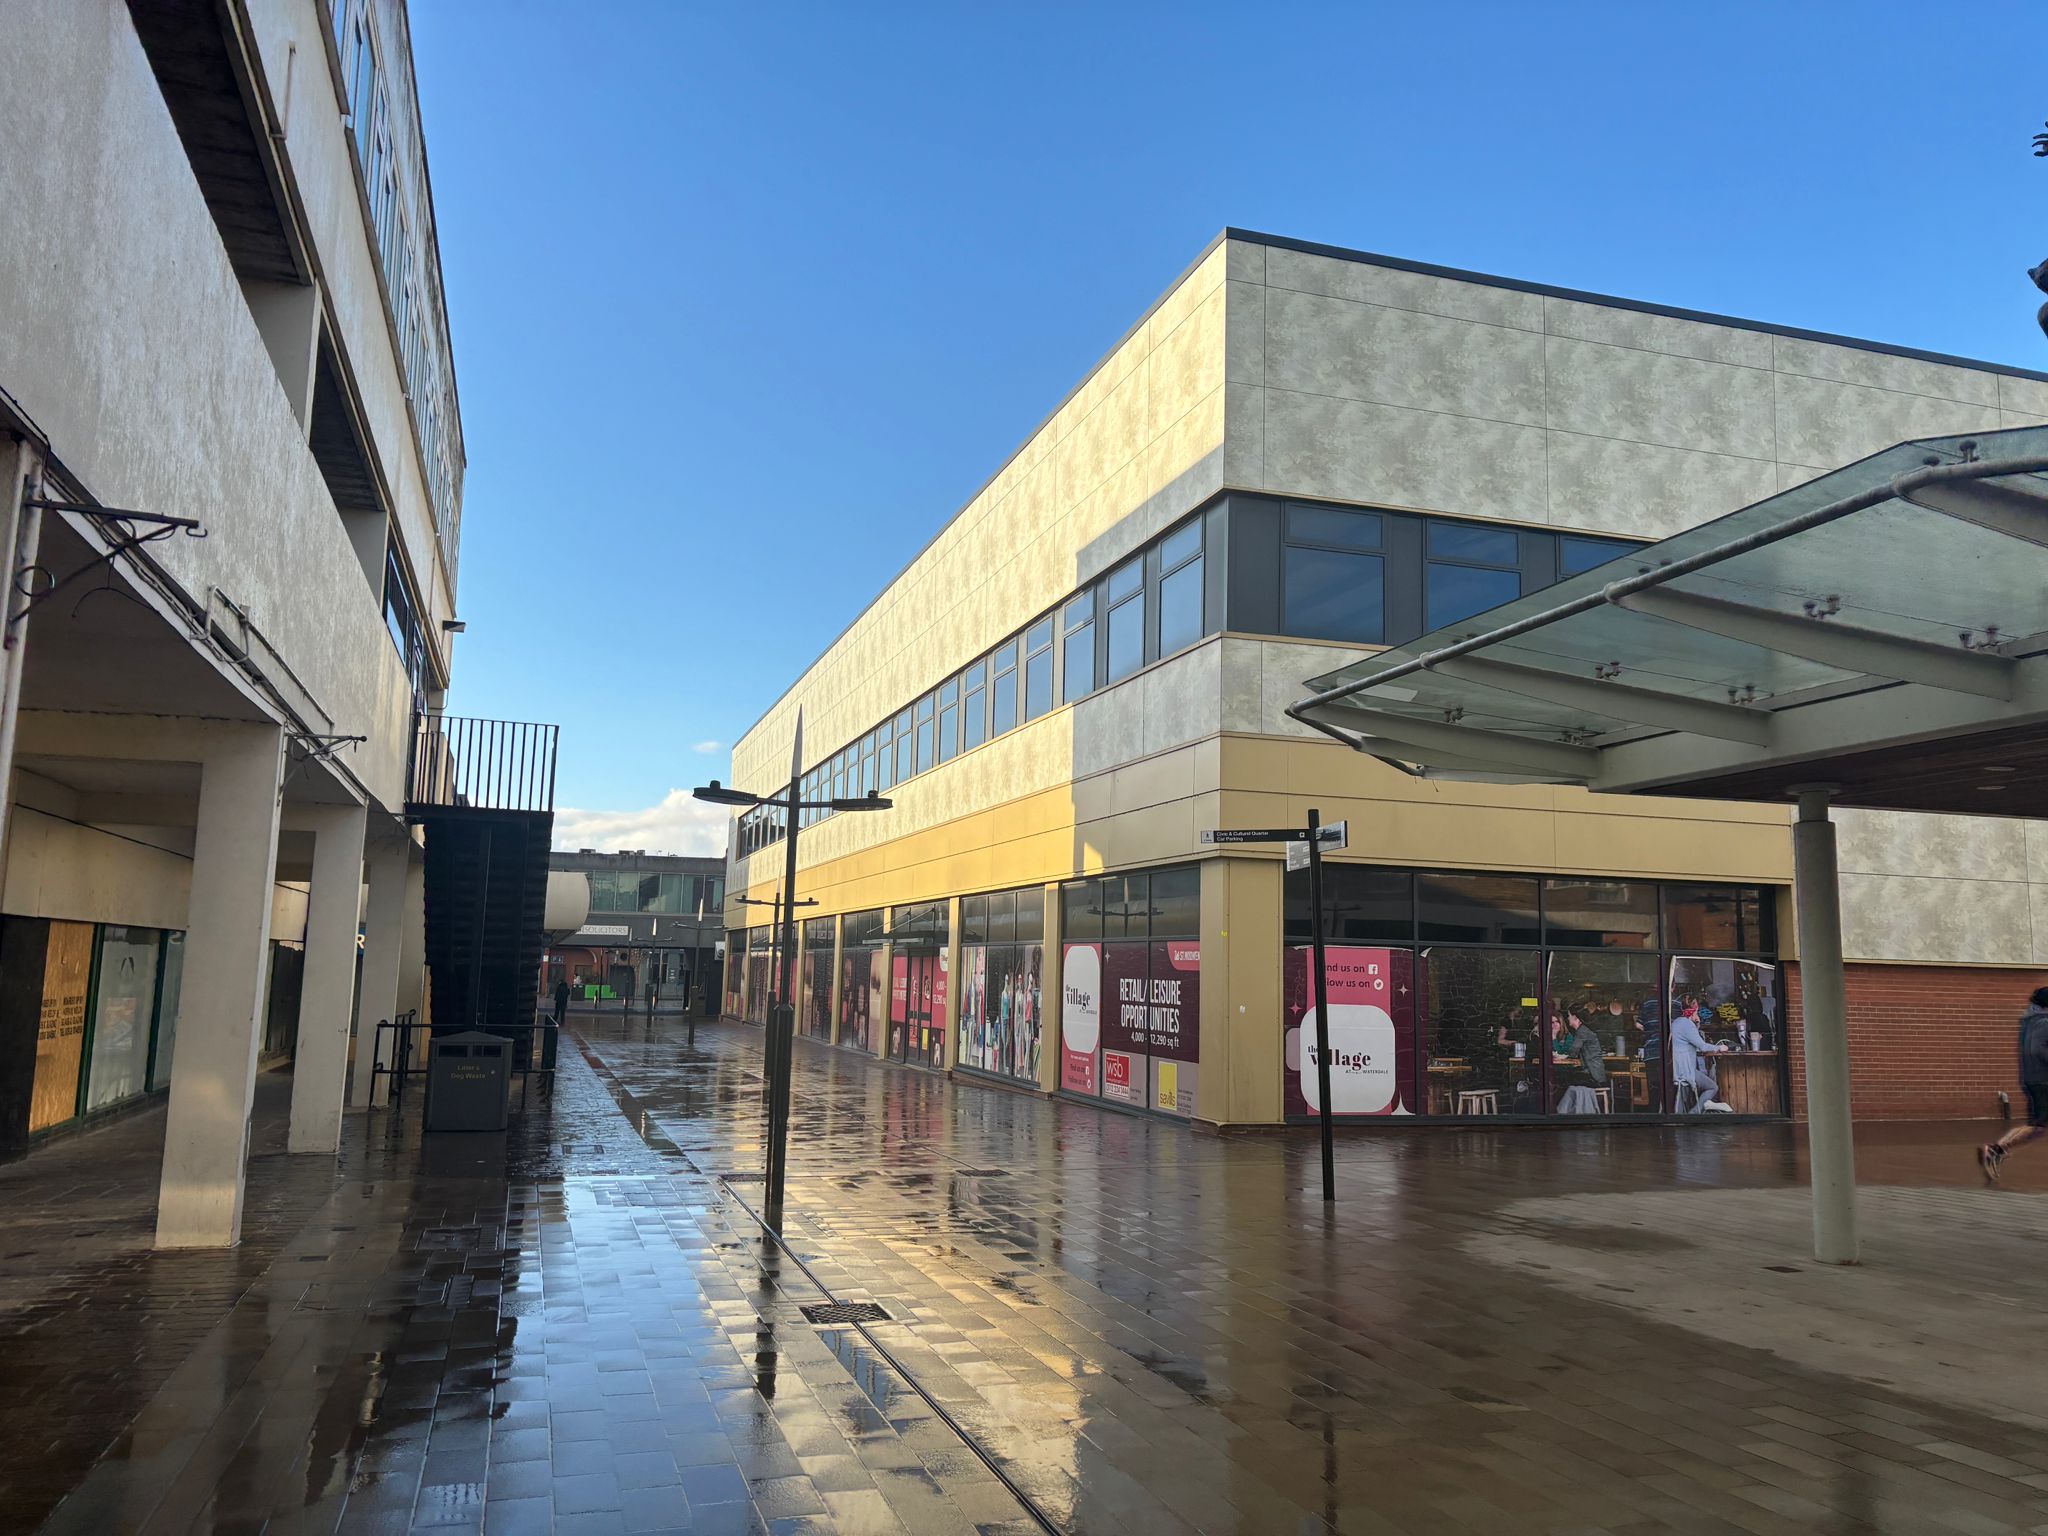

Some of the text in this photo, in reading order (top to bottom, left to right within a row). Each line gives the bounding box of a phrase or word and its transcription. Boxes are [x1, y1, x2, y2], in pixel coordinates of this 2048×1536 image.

[1066, 988, 1090, 1011] village
[1150, 979, 1181, 1005] LEISURE
[1131, 1032, 1144, 1044] 4,000
[1150, 1034, 1167, 1046] 12,290
[1167, 1038, 1174, 1050] sq
[1174, 1036, 1180, 1048] ft
[1310, 1049, 1371, 1071] vllage
